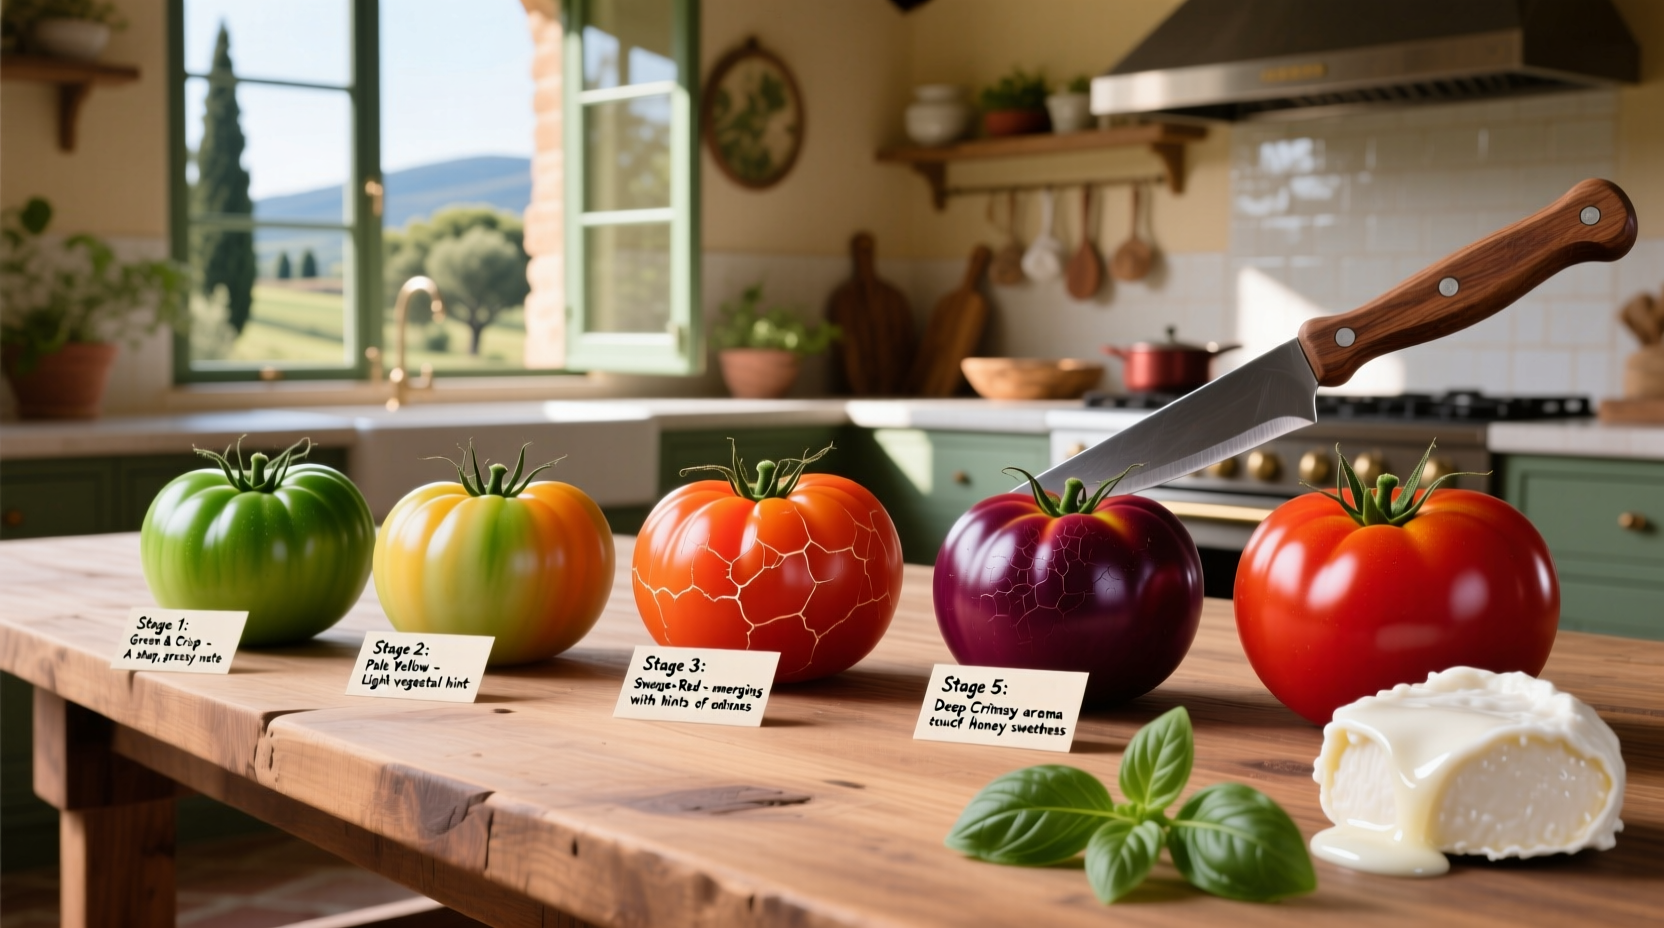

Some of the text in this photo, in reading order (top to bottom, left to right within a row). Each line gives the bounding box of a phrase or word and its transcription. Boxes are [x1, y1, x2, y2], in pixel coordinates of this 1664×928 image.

[136, 616, 189, 635] Stage 1:
[123, 649, 132, 660] A
[373, 640, 430, 660] Stage 2:
[365, 659, 389, 671] Pale
[394, 659, 430, 673] Yellow
[643, 655, 706, 677] Stage 3:
[361, 674, 390, 690] Light
[445, 676, 471, 689] hint
[941, 675, 1008, 699] Stage 5:
[630, 694, 656, 706] with
[694, 697, 710, 710] of
[934, 698, 966, 717] Deep
[1023, 708, 1063, 720] aroma
[969, 716, 1007, 736] Honey
